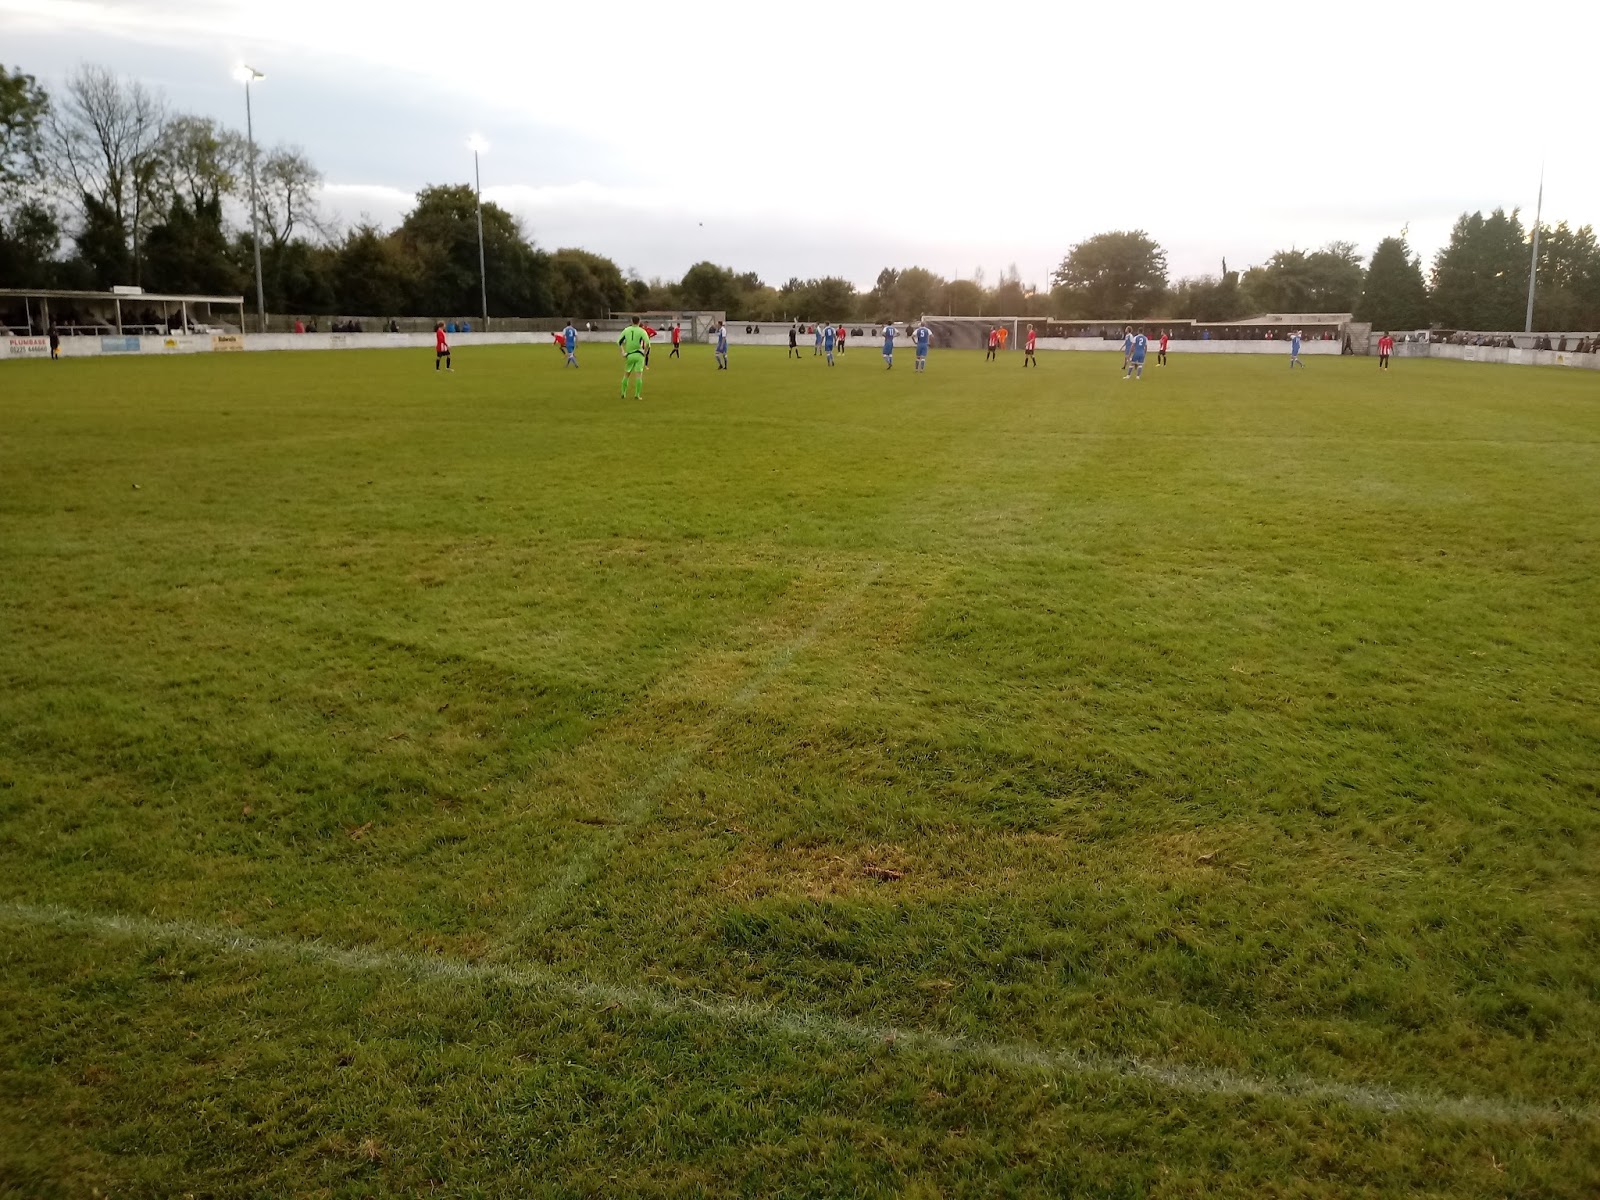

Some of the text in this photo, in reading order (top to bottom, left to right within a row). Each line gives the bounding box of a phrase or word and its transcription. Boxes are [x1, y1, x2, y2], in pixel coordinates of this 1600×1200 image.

[568, 329, 573, 337] 3
[888, 328, 894, 336] 11
[920, 329, 925, 337] 5
[9, 338, 46, 346] PLUMBASE
[1138, 337, 1144, 346] 2
